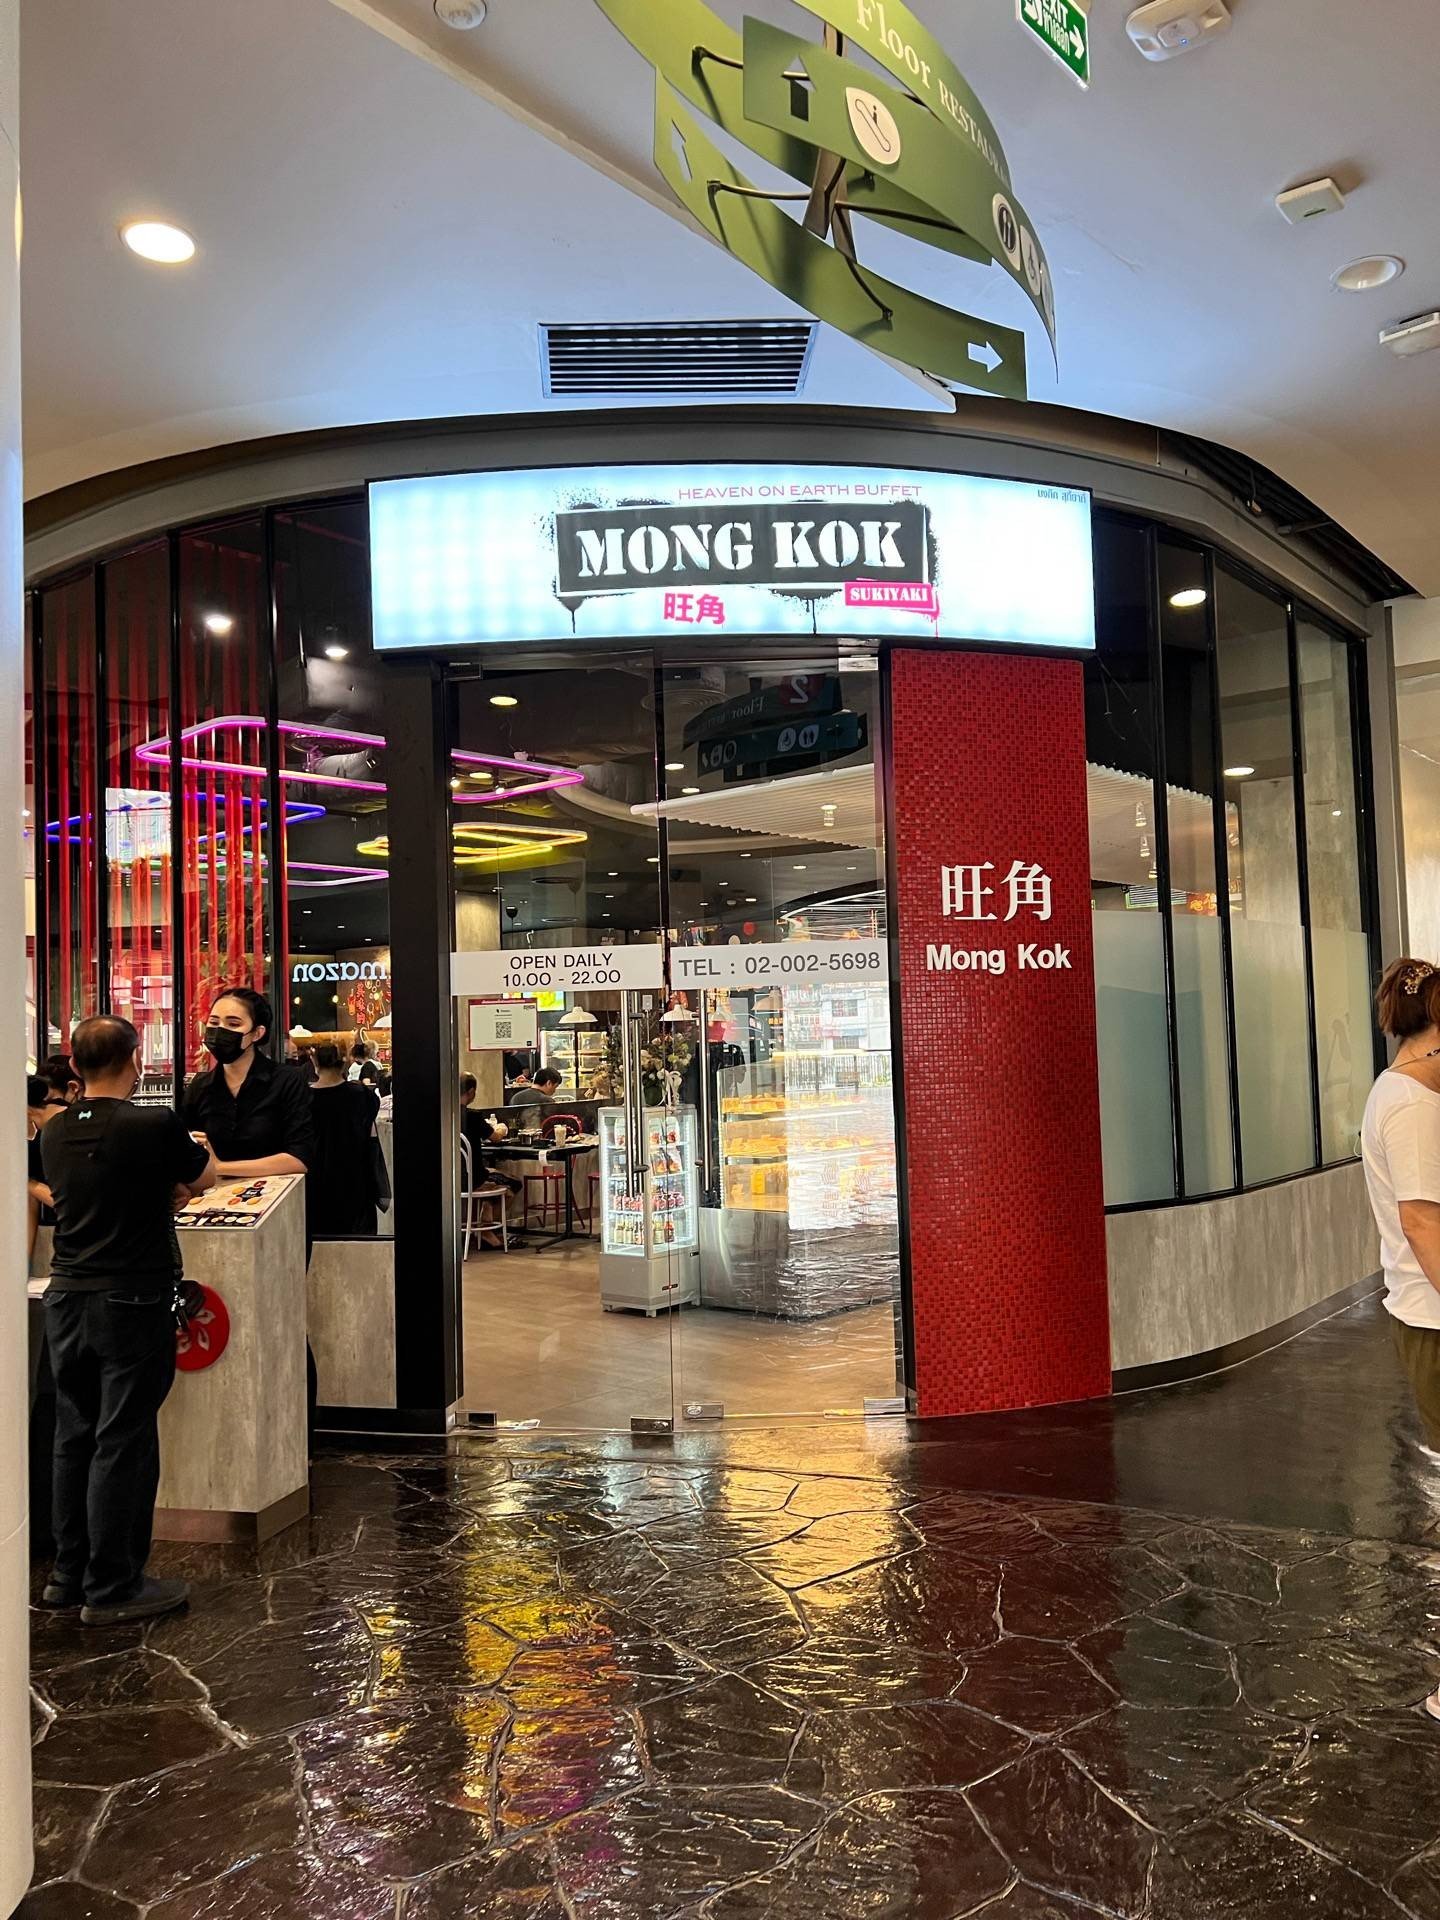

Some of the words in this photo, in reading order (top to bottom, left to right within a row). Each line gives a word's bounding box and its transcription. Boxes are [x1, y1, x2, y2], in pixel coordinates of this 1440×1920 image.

[857, 0, 931, 90] Floor
[678, 486, 753, 500] HEAVEN
[758, 485, 785, 497] ON
[790, 484, 850, 497] EARTH
[854, 485, 923, 497] BUFFET
[576, 522, 754, 578] MONG
[771, 520, 906, 568] KOK
[664, 593, 726, 625] 旺角
[850, 586, 929, 602] SUKIYAKI
[941, 860, 1052, 922] 旺角
[510, 955, 556, 970] OPEN
[563, 952, 613, 968] DAILY
[678, 958, 721, 976] TEL
[745, 951, 881, 974] 02-002-5698
[926, 944, 1005, 975] Mong
[1017, 943, 1073, 970] Kok
